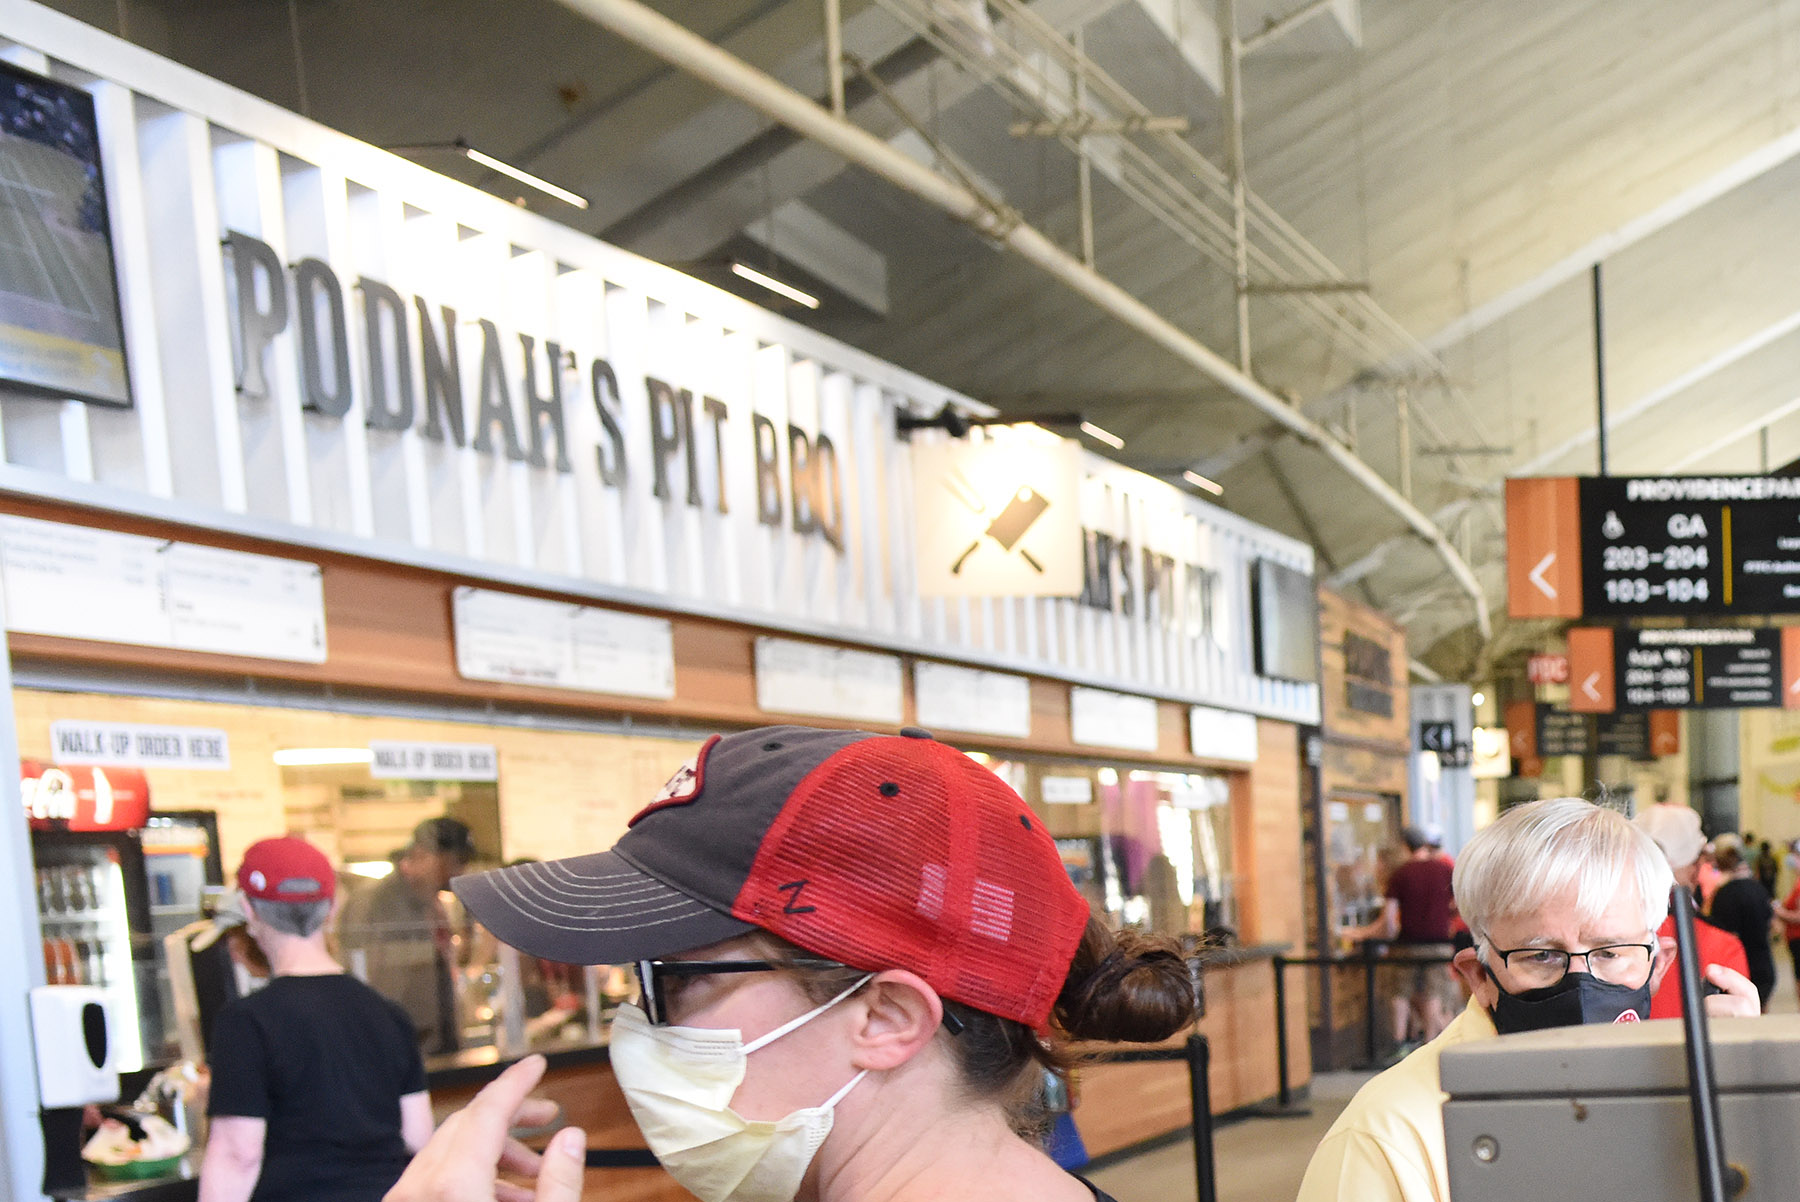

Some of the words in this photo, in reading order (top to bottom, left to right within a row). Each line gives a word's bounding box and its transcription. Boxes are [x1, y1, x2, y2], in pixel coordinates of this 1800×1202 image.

[220, 229, 629, 487] PODNAH'S
[645, 376, 728, 515] PIT
[752, 411, 845, 554] BBQ
[1667, 512, 1709, 540] GA
[1603, 545, 1709, 571] 203-204
[1604, 578, 1710, 604] 103-104
[56, 729, 104, 754] WALK
[110, 732, 130, 755] UP
